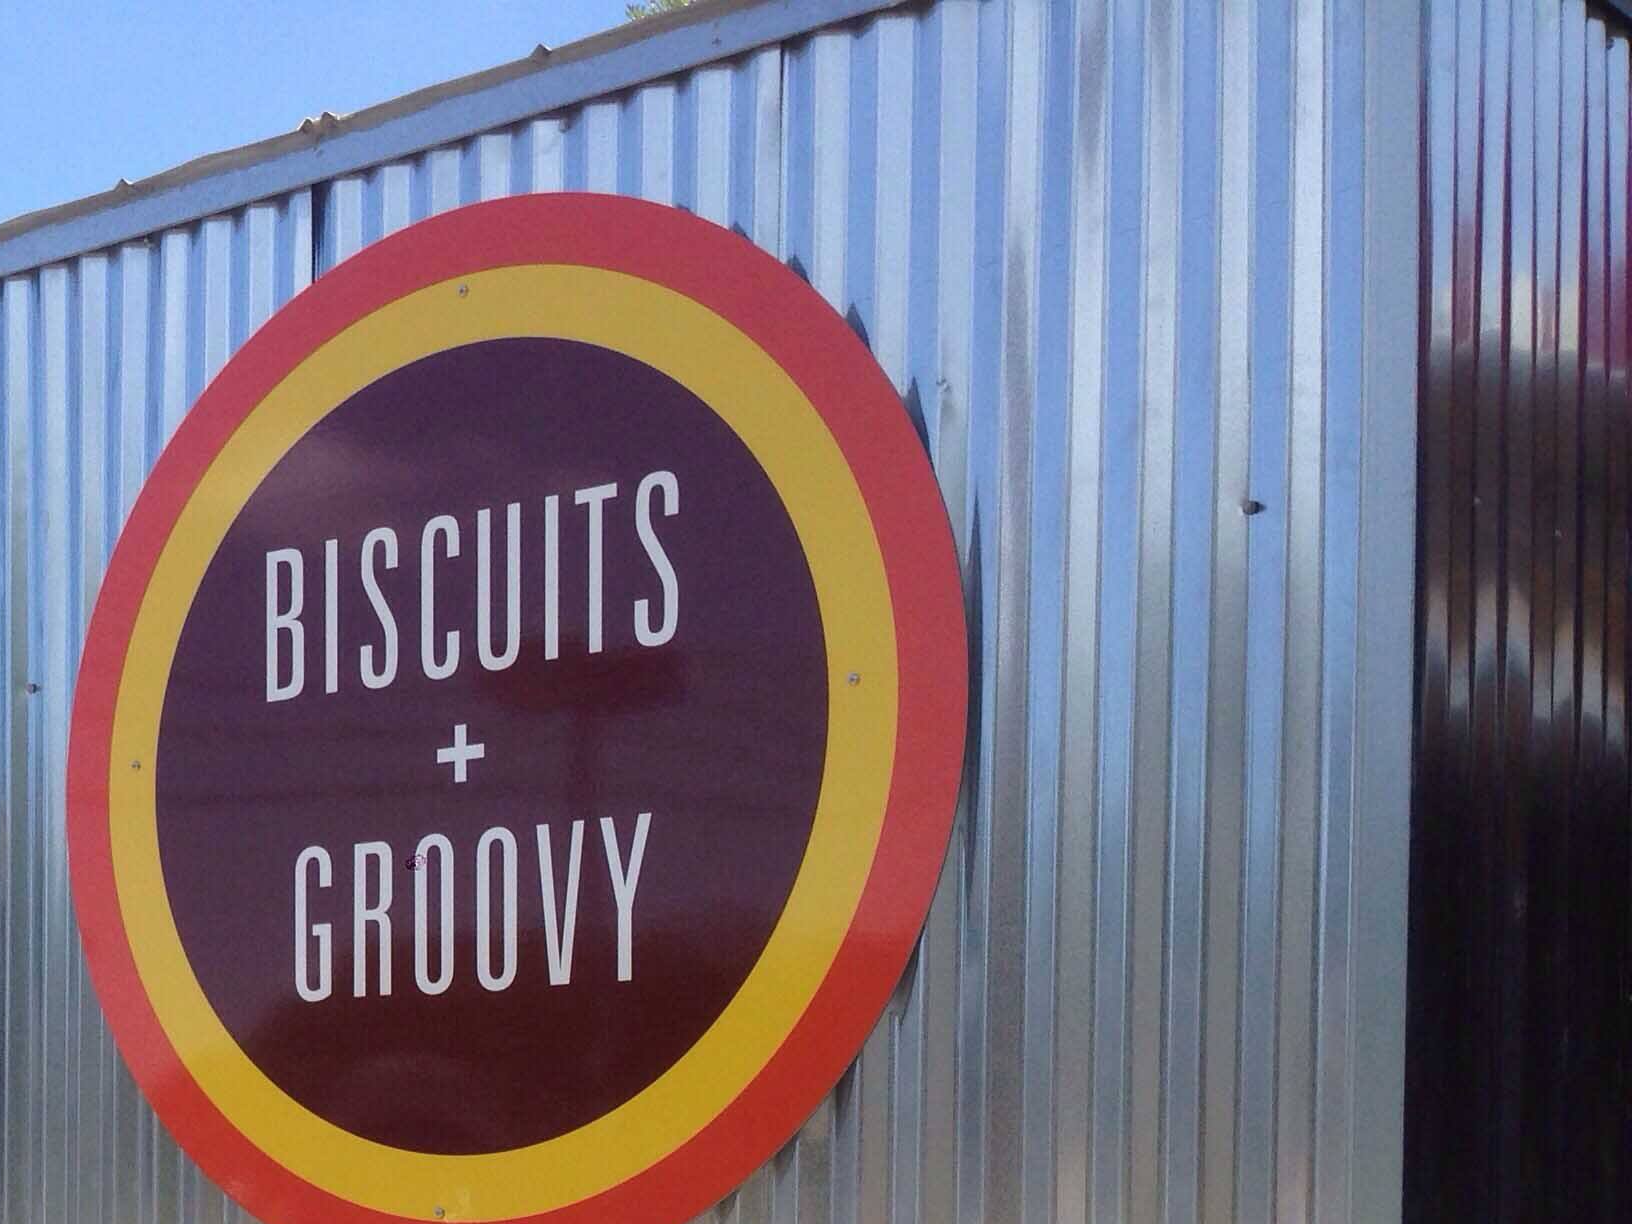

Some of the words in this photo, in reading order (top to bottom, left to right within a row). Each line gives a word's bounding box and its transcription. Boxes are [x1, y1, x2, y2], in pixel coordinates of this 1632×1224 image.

[266, 470, 679, 703] BISCUITS
[436, 723, 485, 783] +
[294, 812, 652, 1002] GROOVY
